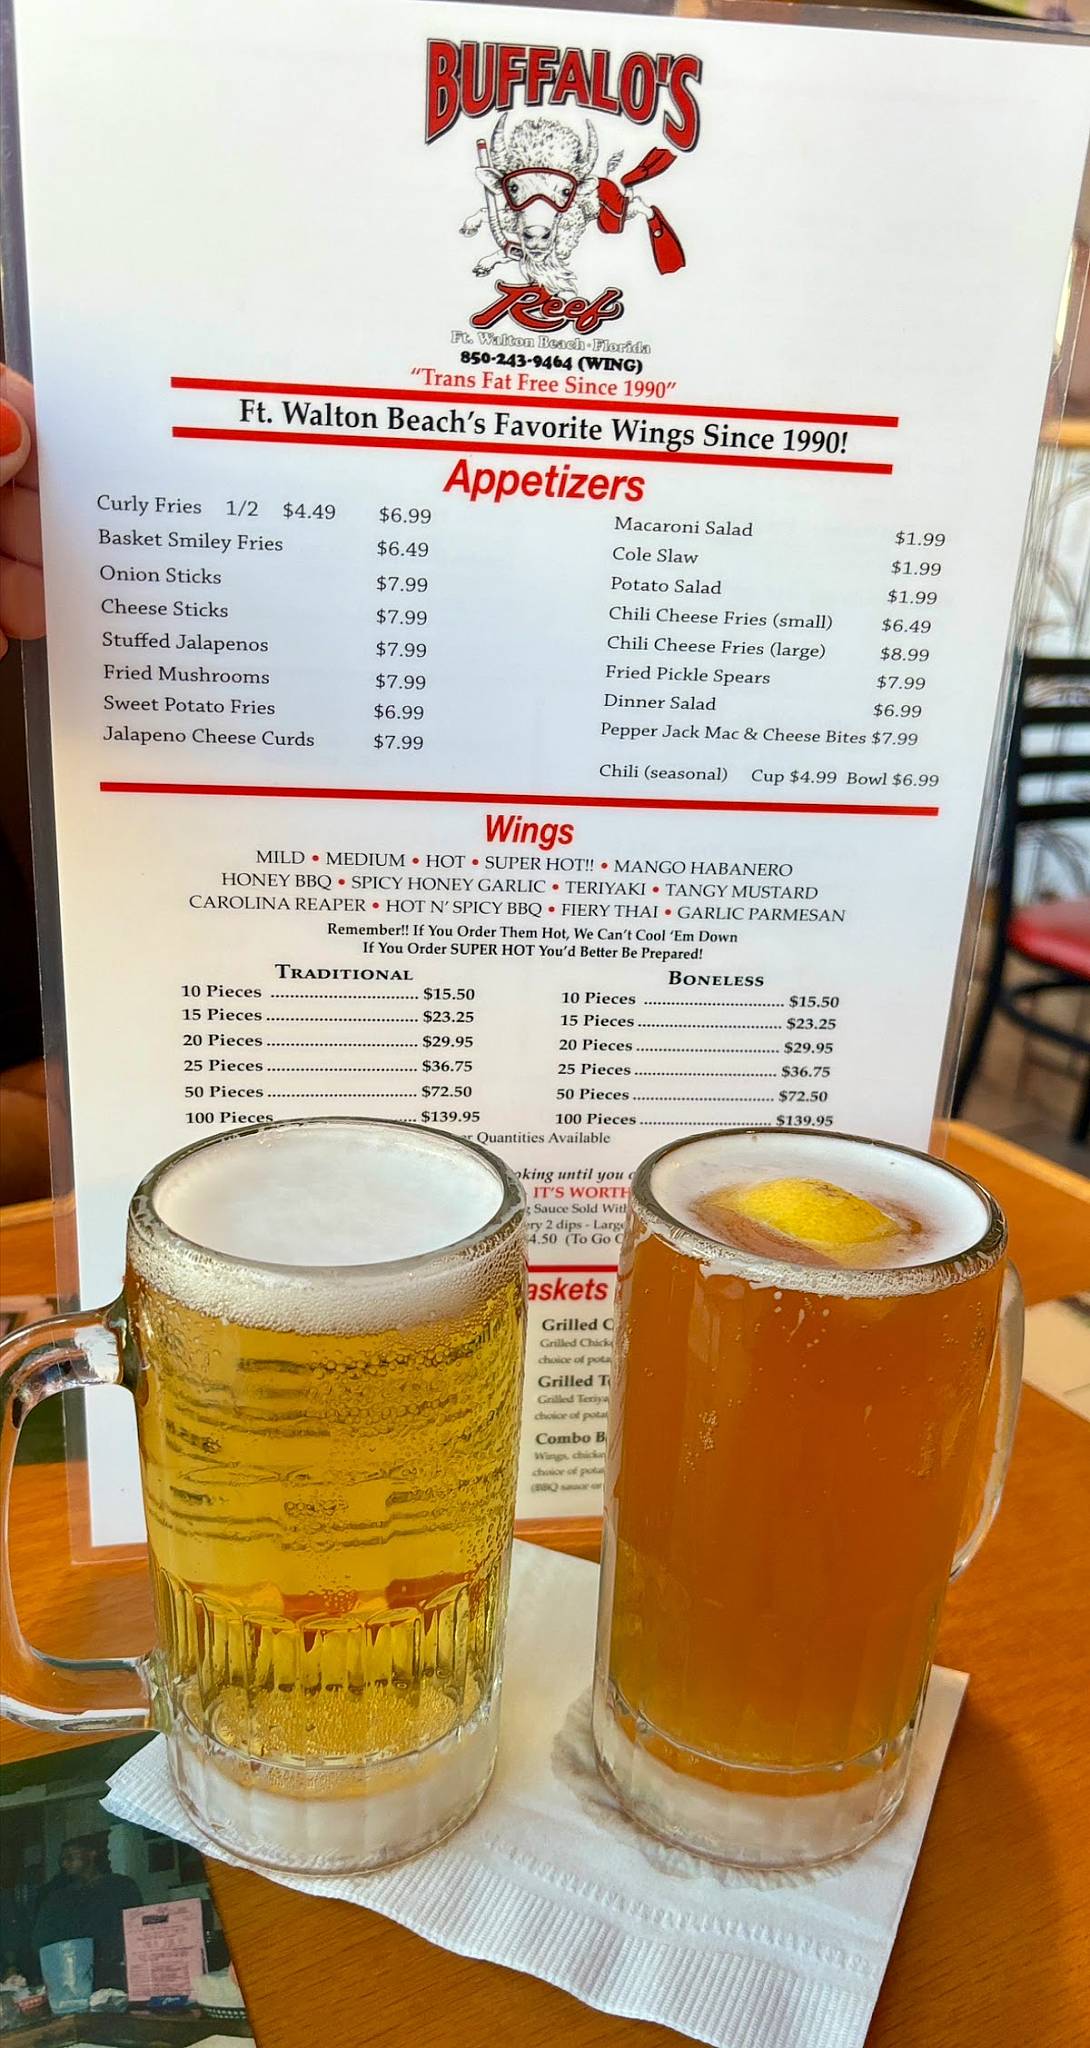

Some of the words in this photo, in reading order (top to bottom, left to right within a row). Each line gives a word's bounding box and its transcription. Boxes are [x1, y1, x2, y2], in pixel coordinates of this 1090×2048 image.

[425, 38, 703, 153] BUFFALO'S
[470, 279, 624, 335] Reef
[460, 350, 573, 371] 850-243-9464
[577, 356, 643, 375] (WING)
[411, 367, 476, 388] "Trans
[481, 371, 512, 390] Fat
[517, 373, 559, 393] Free
[565, 375, 618, 396] Since
[624, 380, 677, 399] 1990"
[239, 399, 272, 424] Ft.
[281, 401, 379, 429] Walton
[387, 407, 486, 435] Beach's
[494, 412, 603, 441] Favorite
[611, 419, 695, 452] Wings
[704, 424, 774, 450] Since
[783, 429, 848, 454] 1990!
[442, 458, 645, 503] Appetizers
[97, 494, 149, 517] Curly
[155, 497, 202, 514] Fries
[226, 500, 258, 517] 1/2
[283, 502, 336, 520] $4.49
[379, 506, 431, 524] $6.99
[98, 528, 163, 547] Basket
[168, 531, 232, 554] Smiley
[237, 534, 283, 551] Fries
[377, 539, 429, 558] $6.49
[614, 516, 699, 534] Macaroni
[705, 521, 753, 537] Salad
[895, 530, 946, 547] $1.99
[612, 546, 652, 562] Cole
[656, 548, 699, 564] Slaw
[891, 560, 941, 576] $1.99
[101, 598, 167, 616] Cheese
[173, 601, 228, 618] Sticks
[376, 608, 427, 626] $7.99
[609, 605, 650, 621] Chili
[656, 608, 718, 624] Cheese
[723, 611, 767, 626] Fries
[773, 613, 833, 631] (small)
[881, 618, 931, 634] $6.49
[102, 631, 171, 649] Stuffed
[175, 634, 268, 655] Jalapenos
[376, 640, 427, 658] $7.99
[605, 664, 651, 680] Fried
[656, 666, 708, 682] Pickle
[713, 669, 770, 687] Spears
[876, 675, 926, 690] $7.99
[603, 693, 666, 709] Dinner
[670, 696, 716, 711] Salad
[873, 703, 922, 718] $6.99
[103, 725, 186, 746] Jalapeno
[192, 728, 256, 745] Cheese
[261, 730, 315, 747] Curds
[373, 733, 424, 750] $7.99
[601, 722, 658, 740] Pepper
[662, 724, 700, 739] Jack
[704, 726, 740, 740] Mac
[743, 727, 758, 741] &
[763, 727, 821, 743] Cheese
[825, 730, 867, 744] Bites
[871, 730, 918, 746] $7.99
[599, 763, 639, 778] Chili
[644, 765, 728, 783] (seasonal)
[751, 769, 785, 786] Cup
[790, 769, 837, 784] $4.99
[846, 772, 887, 785] Bowl
[892, 773, 939, 787] $6.99
[486, 814, 574, 851] Wings
[256, 850, 305, 864] MILD
[326, 851, 406, 867] MEDIUM
[426, 854, 466, 868] HOT
[485, 856, 541, 871] SUPER
[545, 857, 594, 872] HOT!!
[614, 859, 686, 874] MANGO
[690, 861, 793, 877] HABANERO
[221, 872, 291, 887] HONEY
[294, 874, 332, 891] BBQ
[351, 875, 403, 890] SPICY
[408, 877, 474, 891] HONEY
[477, 878, 546, 893] GARLIC
[565, 881, 646, 896] TERIYAKI
[665, 883, 728, 898] TANGY
[731, 885, 818, 900] MUSTARD
[189, 895, 291, 910] CAROLINA
[295, 897, 366, 912] REAPER
[386, 899, 426, 913] HOT
[430, 900, 449, 913] N'
[452, 900, 503, 915] SPICY
[507, 902, 542, 918] BBQ
[561, 903, 611, 917] FIERY
[614, 904, 659, 918] THAI
[677, 906, 745, 920] GARLIC
[748, 907, 846, 922] PARMESAN
[327, 922, 409, 936] Remember!!
[412, 924, 425, 936] If
[427, 924, 453, 937] You
[457, 925, 497, 938] Order
[499, 926, 538, 939] Them
[541, 927, 570, 942] Hot,
[574, 927, 594, 940] We
[597, 928, 633, 941] Can't
[635, 929, 666, 942] Cool
[669, 930, 694, 942] 'Em
[699, 930, 738, 943] Down
[363, 941, 375, 954] If
[377, 941, 404, 954] You
[407, 942, 448, 955] Order
[450, 943, 498, 956] SUPER
[501, 944, 536, 956] HOT
[538, 944, 576, 957] You'd
[580, 945, 619, 958] Better
[621, 946, 638, 959] Be
[641, 947, 703, 963] Prepared!
[274, 963, 414, 981] TRADITIONAL
[668, 970, 764, 987] BONELESS
[181, 985, 201, 998] 10
[206, 985, 262, 998] Pieces
[423, 987, 475, 1001] $15.50
[561, 1014, 578, 1027] 15
[583, 1014, 635, 1027] Pieces
[786, 1017, 836, 1031] $23.25
[184, 1059, 203, 1072] 25
[208, 1059, 263, 1072] Pieces
[422, 1059, 473, 1073] $36.75
[556, 1088, 575, 1100] 50
[579, 1088, 629, 1101] Pieces
[778, 1090, 828, 1103] $72.50
[185, 1112, 215, 1124] 100
[219, 1111, 274, 1125] Pieces
[421, 1110, 480, 1124] $139.95
[555, 1113, 582, 1125] 100
[586, 1113, 637, 1125] Pieces
[776, 1114, 833, 1128] $139.95
[476, 1131, 545, 1146] Quantities
[548, 1132, 610, 1144] Available
[558, 1168, 593, 1180] until
[597, 1171, 623, 1183] you
[534, 1187, 565, 1199] IT'S
[534, 1203, 568, 1214] Sauce
[572, 1203, 598, 1214] Sold
[527, 1278, 608, 1300] askets
[542, 1318, 597, 1331] Grilled
[538, 1375, 593, 1388] Grilled
[535, 1432, 592, 1445] Combo
